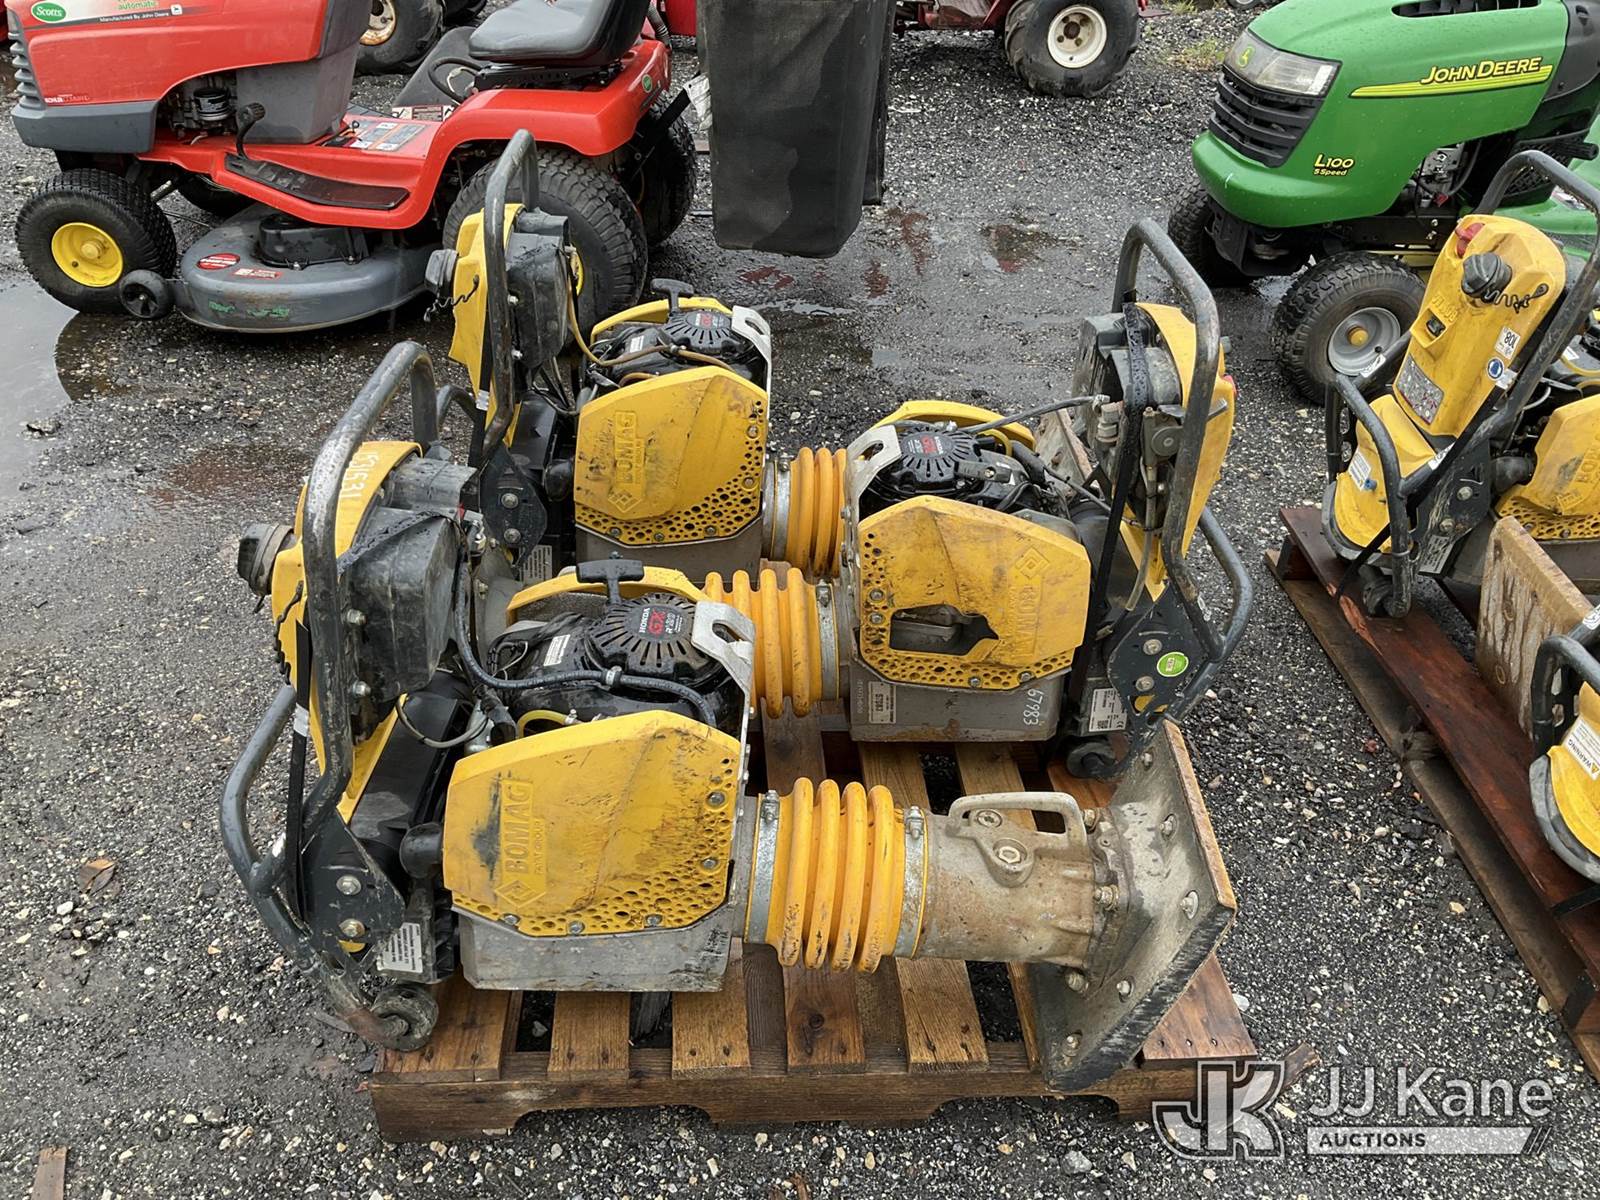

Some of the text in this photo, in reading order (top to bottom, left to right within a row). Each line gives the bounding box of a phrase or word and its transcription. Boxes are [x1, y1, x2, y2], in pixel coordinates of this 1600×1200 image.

[36, 6, 63, 17] Scotts
[1420, 57, 1542, 84] JOHN DEERE
[1314, 154, 1354, 168] L100
[639, 607, 650, 633] HONDA
[1022, 685, 1045, 726] 67983
[1568, 739, 1592, 768] WARNING
[504, 782, 531, 875] BOMAG
